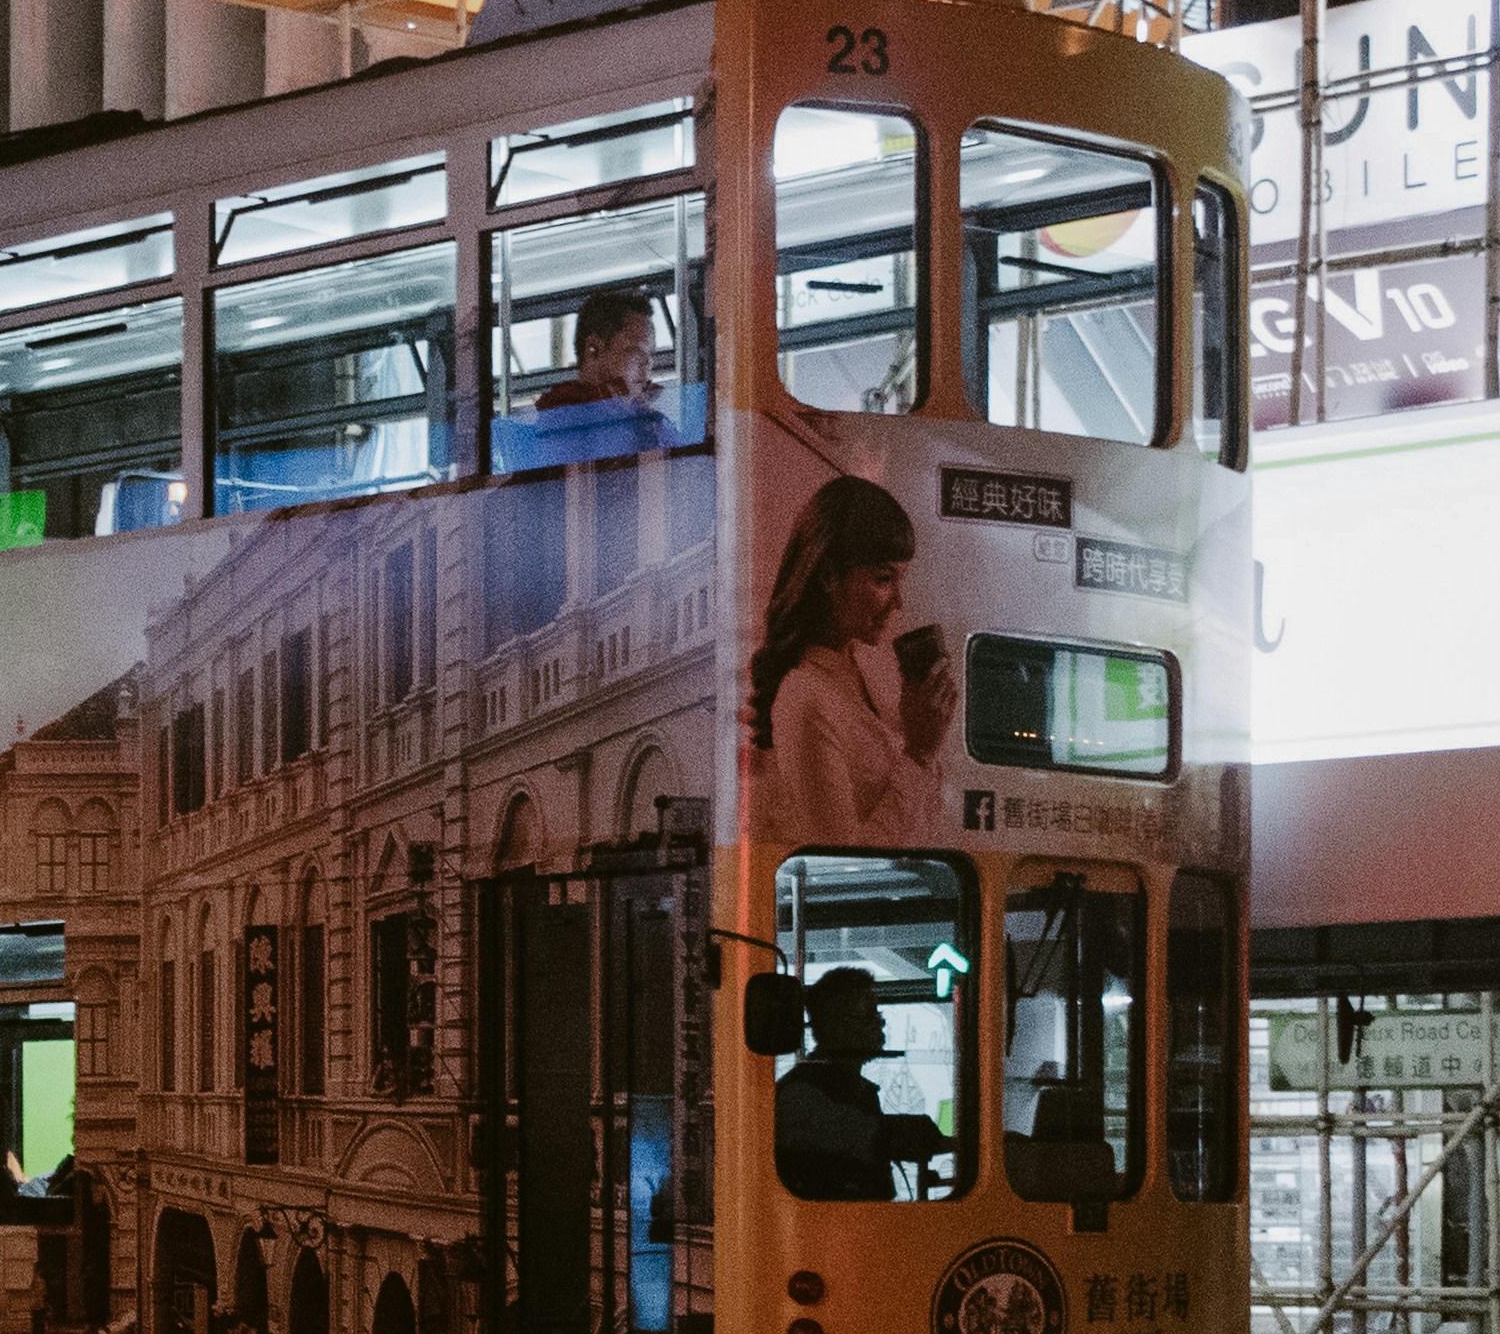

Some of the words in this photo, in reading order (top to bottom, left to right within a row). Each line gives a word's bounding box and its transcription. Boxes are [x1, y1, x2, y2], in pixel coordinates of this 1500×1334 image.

[826, 26, 888, 75] 23
[1251, 140, 1479, 215] OBILE
[951, 477, 1063, 520] 經典好味
[1401, 1021, 1451, 1041] Road
[1083, 1271, 1190, 1323] 舊街場
